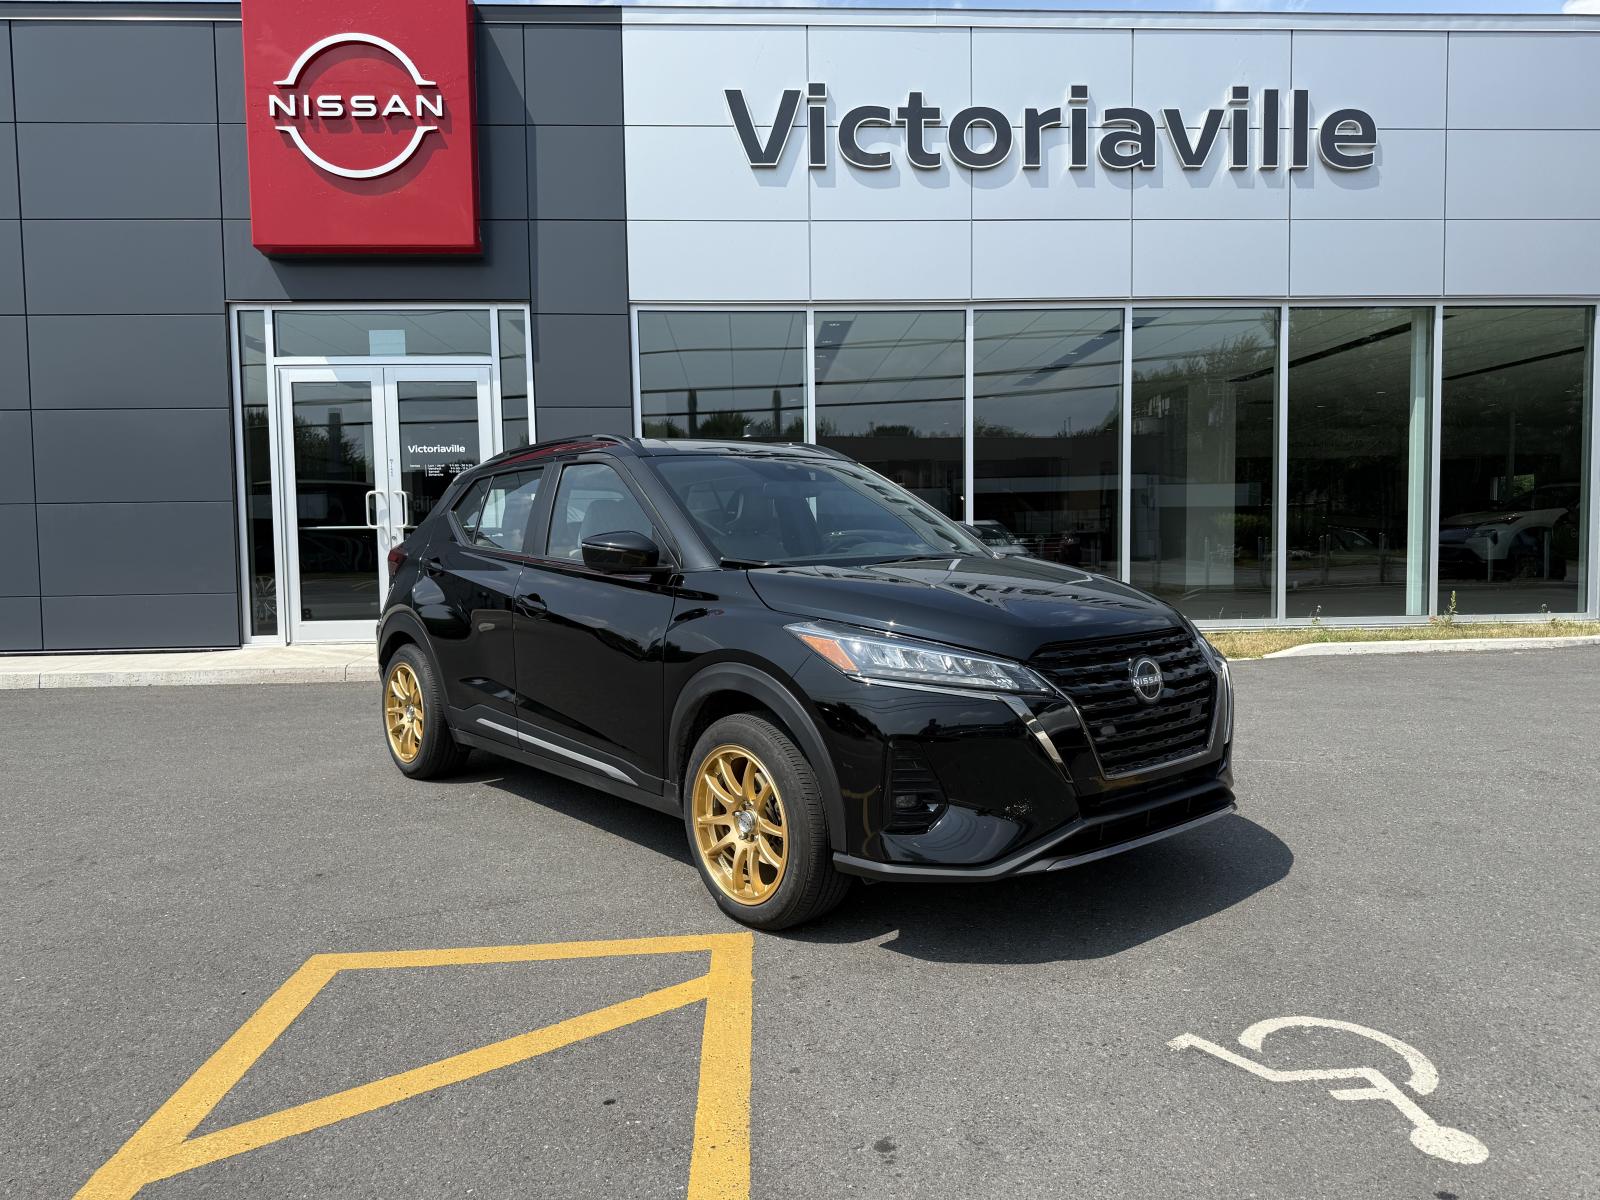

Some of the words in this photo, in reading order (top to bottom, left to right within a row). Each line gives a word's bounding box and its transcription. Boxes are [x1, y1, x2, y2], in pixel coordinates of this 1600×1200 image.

[268, 94, 443, 117] NISSAN
[723, 82, 1379, 171] Victoriaville
[408, 444, 466, 453] Victoriaville
[1132, 675, 1161, 686] NISSAN
